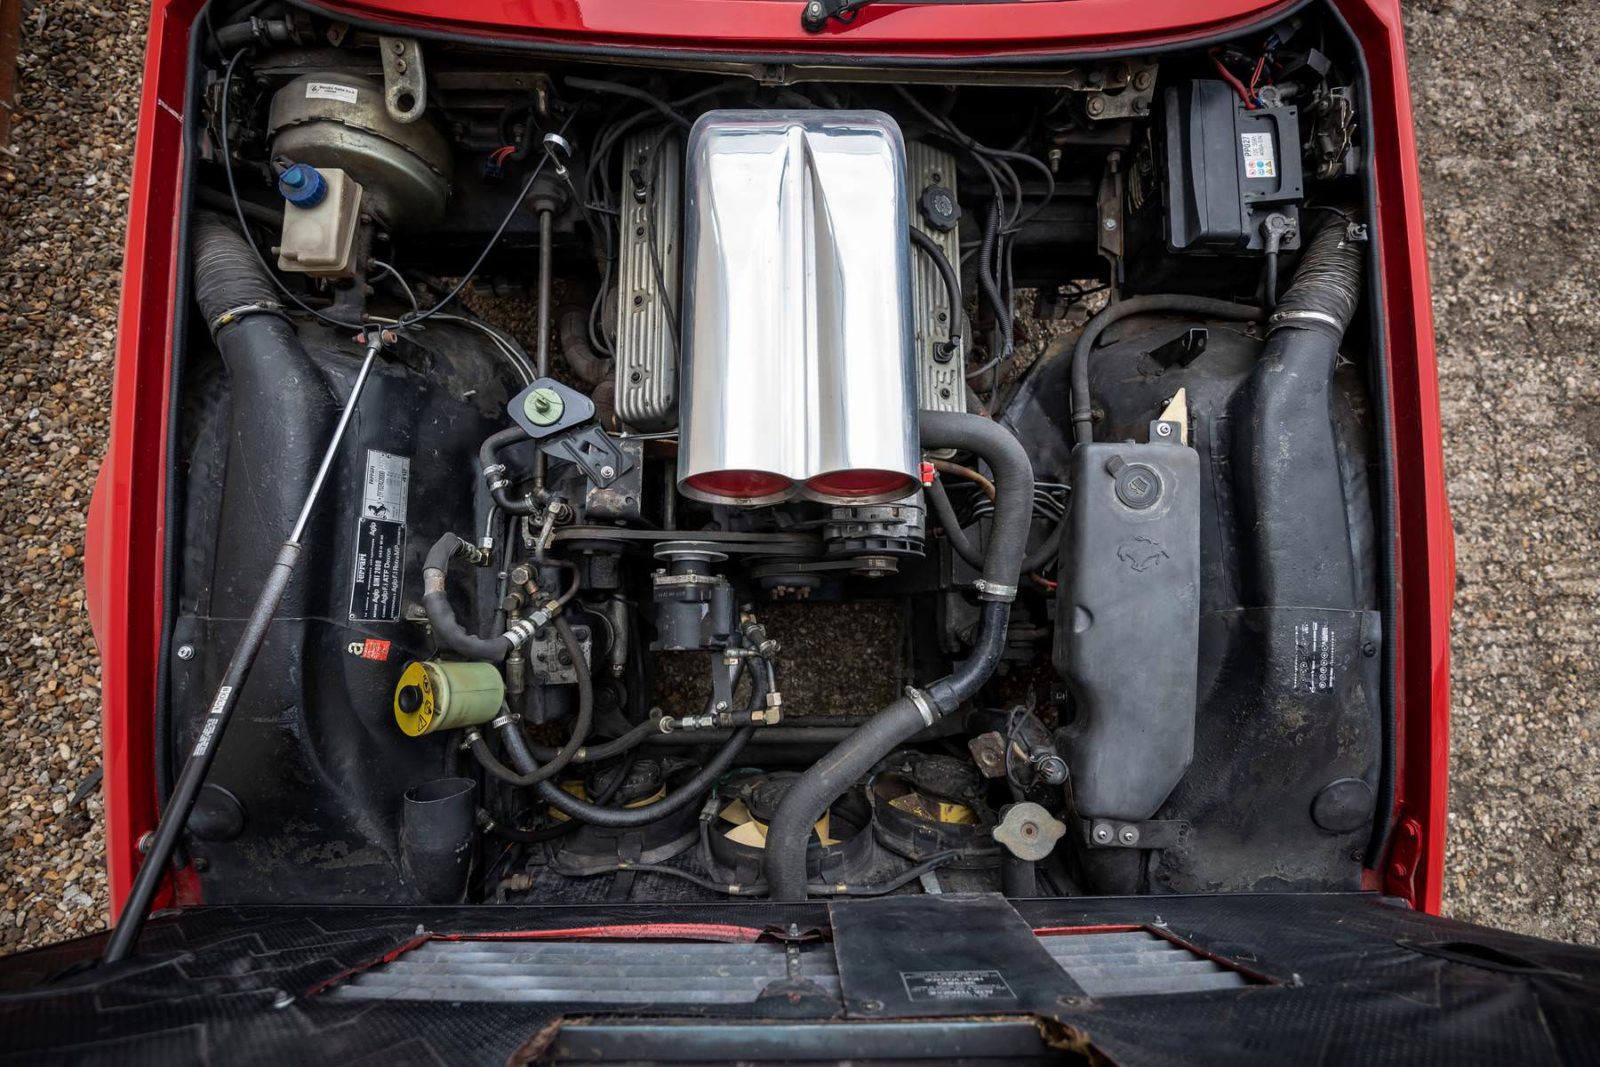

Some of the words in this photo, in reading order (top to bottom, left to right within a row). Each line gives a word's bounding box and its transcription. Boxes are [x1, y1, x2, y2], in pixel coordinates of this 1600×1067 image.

[1243, 136, 1252, 157] PP027
[369, 521, 377, 536] Agip
[356, 553, 367, 583] Ferrari
[391, 578, 399, 592] Agip
[372, 588, 380, 603] Agip
[380, 590, 389, 604] Agip
